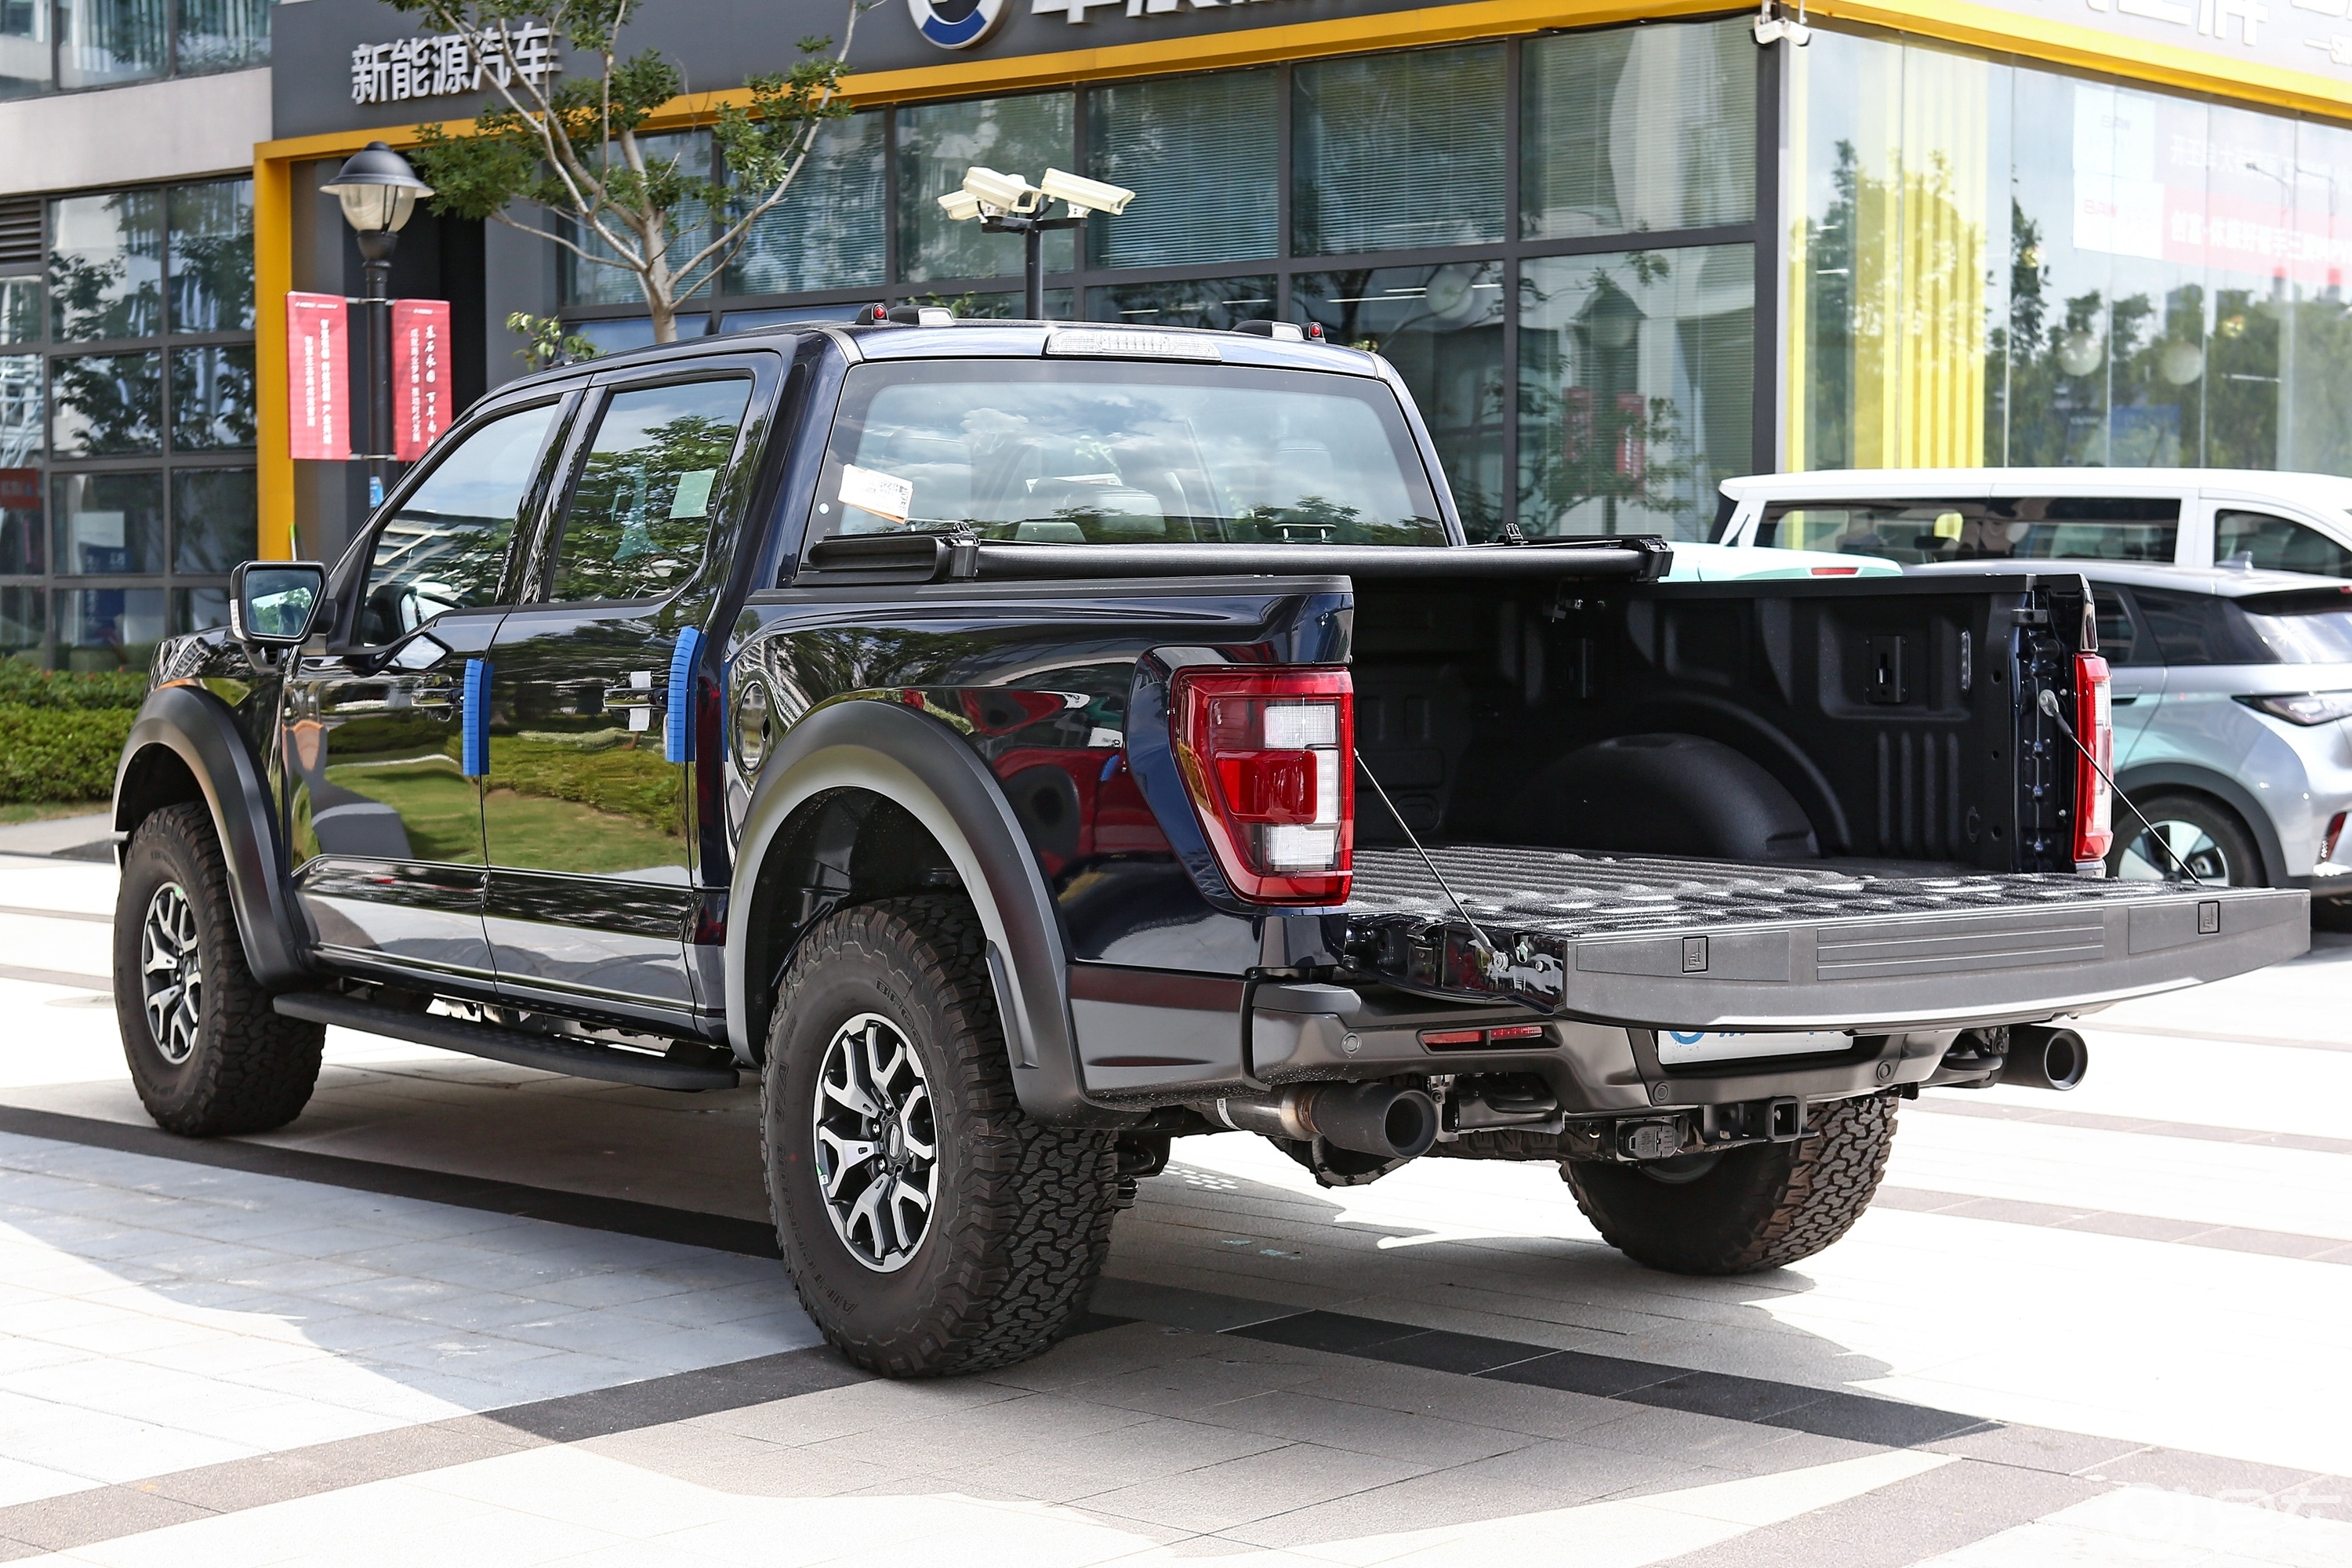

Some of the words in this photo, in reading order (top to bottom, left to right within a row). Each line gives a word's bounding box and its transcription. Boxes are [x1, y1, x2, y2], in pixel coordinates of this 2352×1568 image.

[351, 21, 555, 104] 新能源汽车
